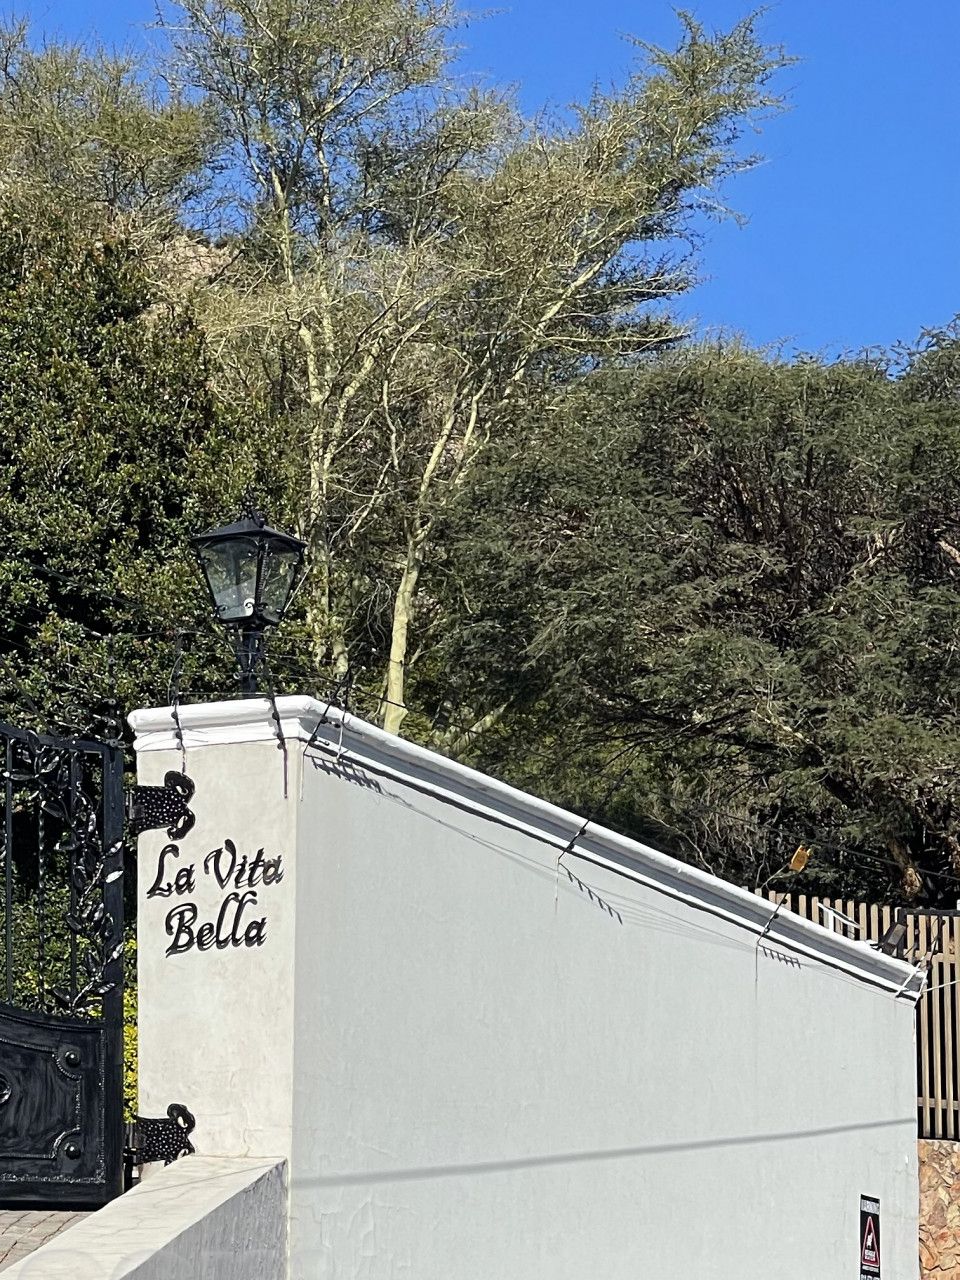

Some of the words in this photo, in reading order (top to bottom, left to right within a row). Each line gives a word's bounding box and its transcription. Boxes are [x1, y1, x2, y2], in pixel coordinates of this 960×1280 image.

[147, 844, 195, 899] La
[204, 839, 284, 889] Vita
[165, 890, 267, 958] Bella
